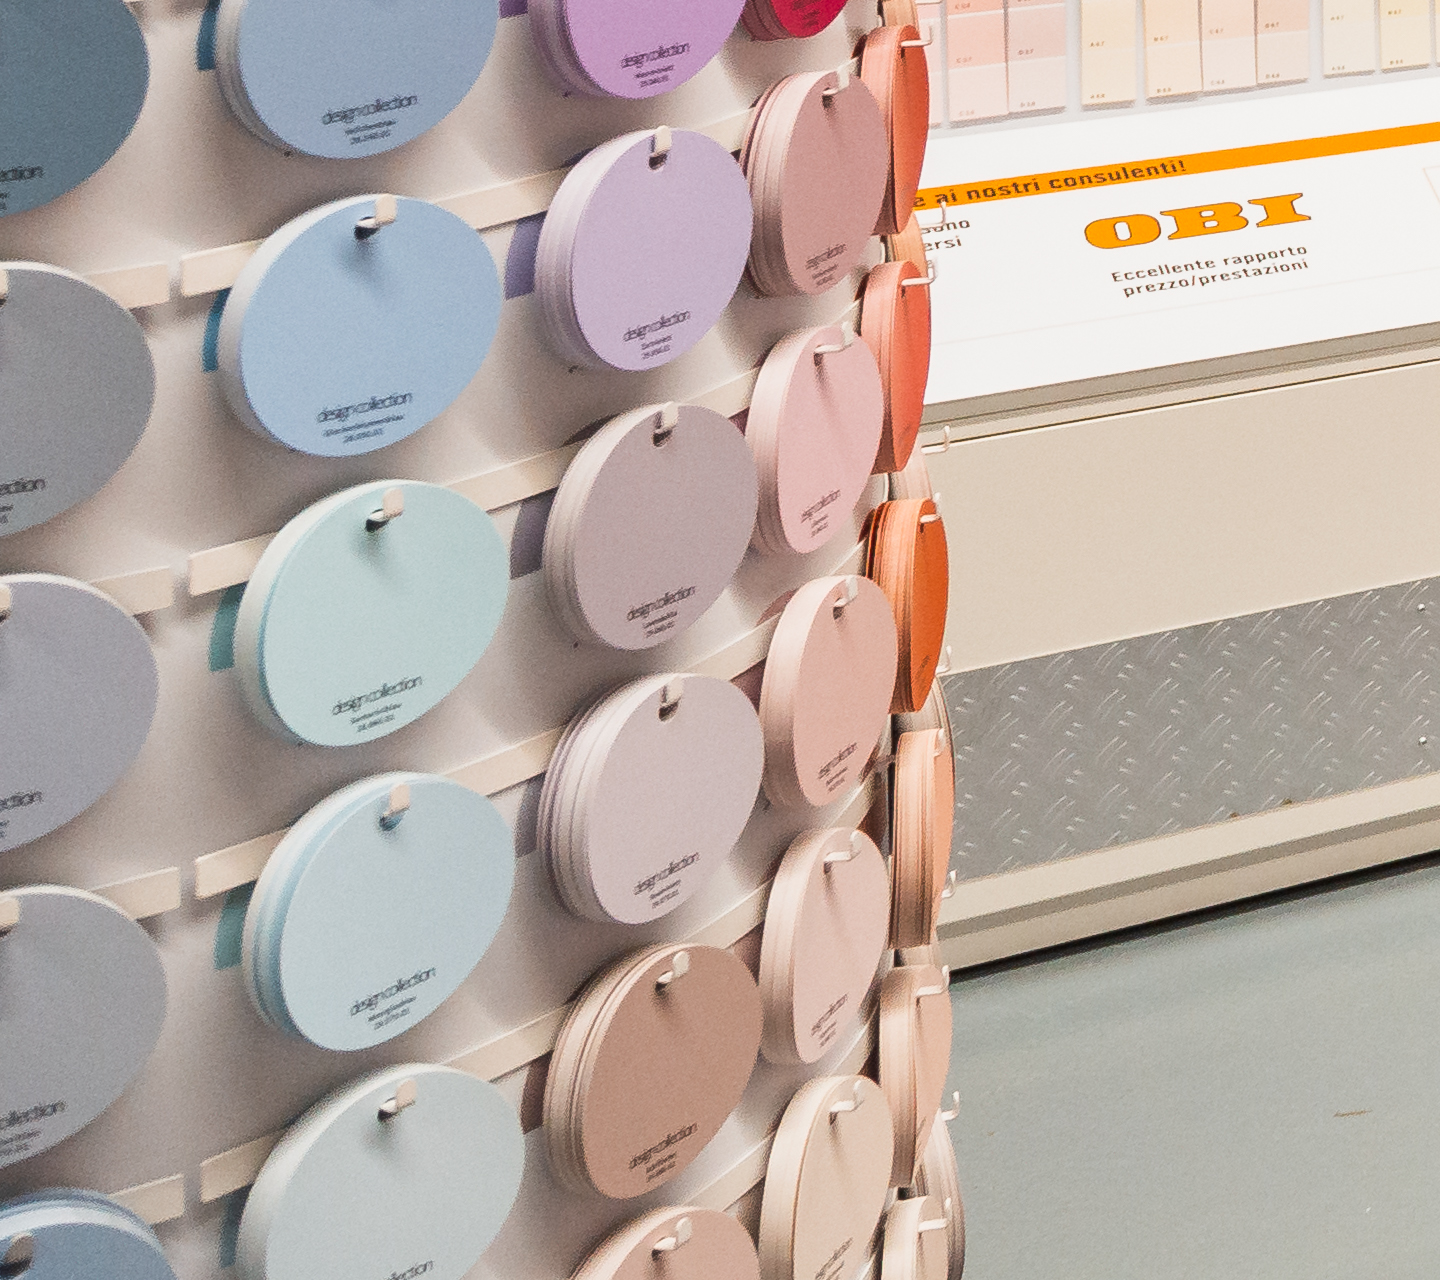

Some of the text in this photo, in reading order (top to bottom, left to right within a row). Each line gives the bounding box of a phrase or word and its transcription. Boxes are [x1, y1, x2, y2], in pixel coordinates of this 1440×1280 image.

[967, 179, 1041, 203] nostri
[1049, 160, 1187, 190] consulenti!
[1083, 192, 1312, 250] OBI
[1111, 244, 1307, 284] Eccellente rapporto
[1122, 258, 1309, 298] prezzo/prestazioni
